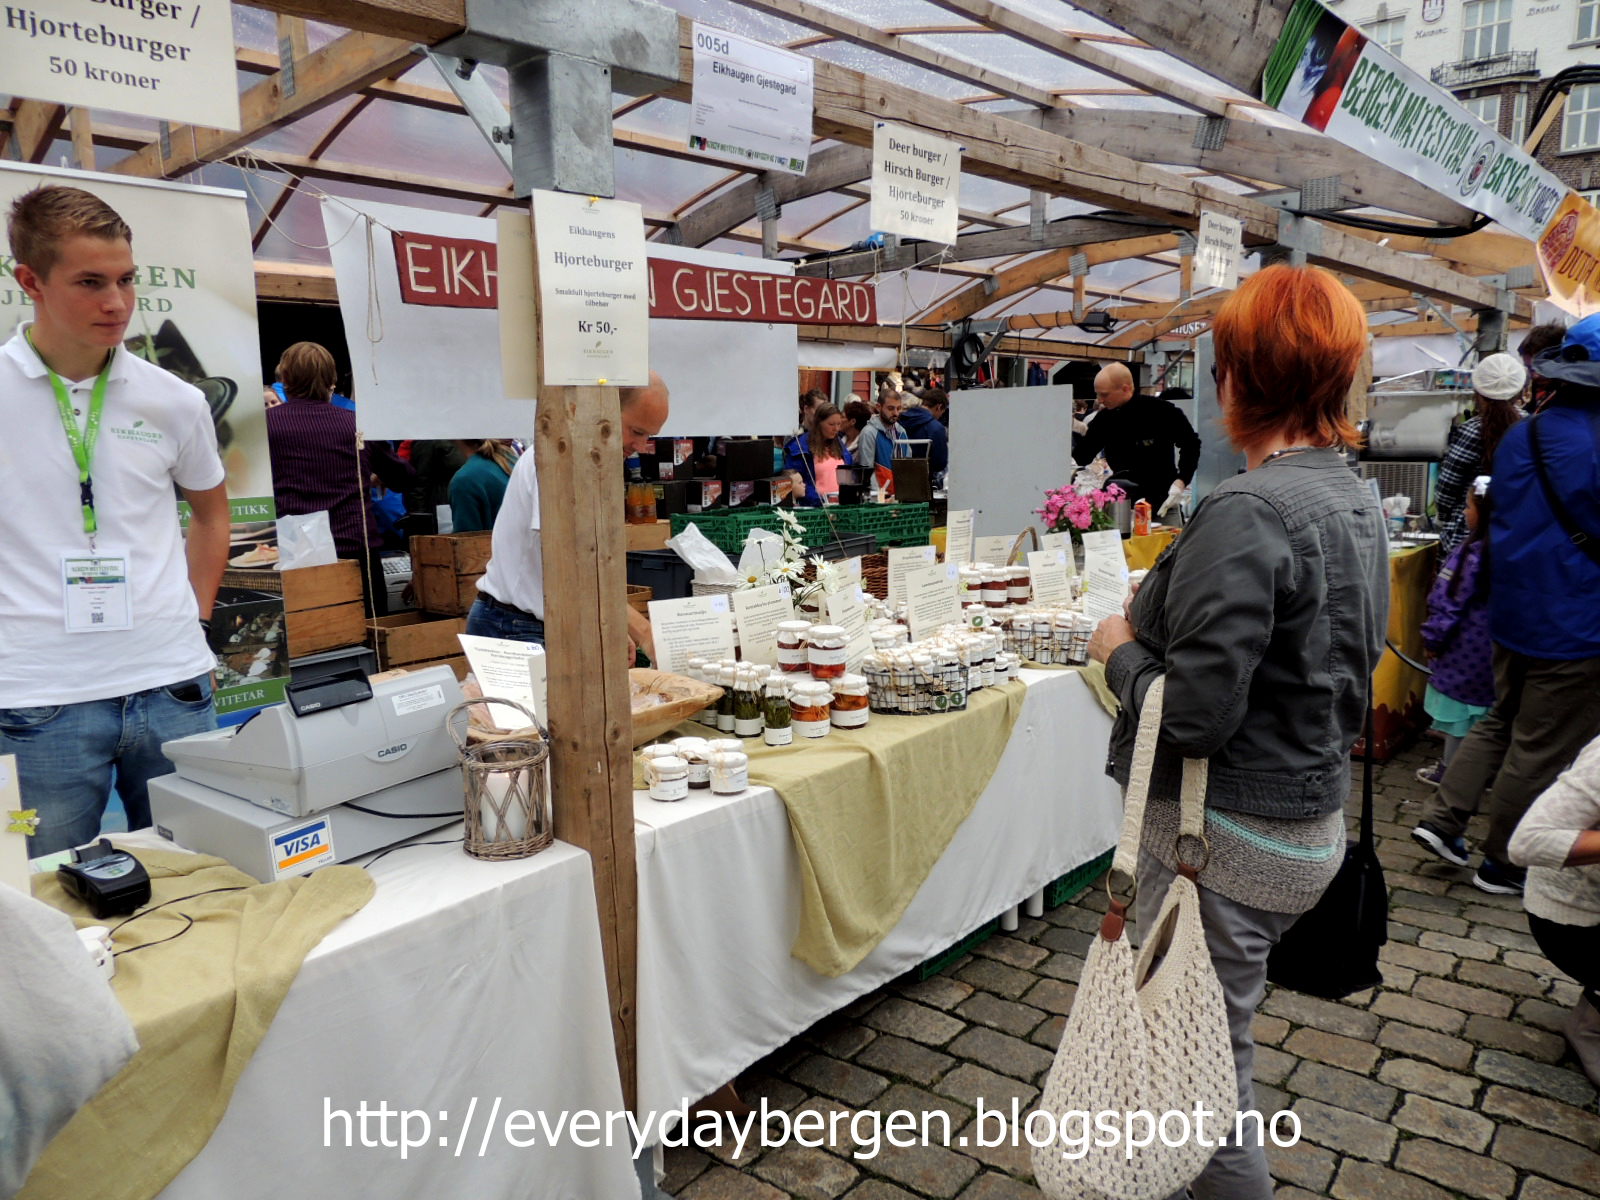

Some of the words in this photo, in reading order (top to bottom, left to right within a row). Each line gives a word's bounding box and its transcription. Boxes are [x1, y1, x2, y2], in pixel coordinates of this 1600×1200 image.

[90, 0, 182, 19] urger
[5, 6, 191, 62] Hjorteburger
[697, 33, 729, 55] 005d
[49, 56, 78, 76] 50
[85, 62, 161, 90] kroner
[713, 61, 755, 84] Eikhaugen
[756, 74, 797, 96] Gjestegard
[1341, 57, 1408, 133] BERGEN
[1390, 92, 1480, 175] MATFESTIVAL
[889, 138, 911, 155] Deer
[912, 144, 942, 163] burger
[884, 160, 913, 179] Hirsch
[915, 168, 945, 187] Burger
[889, 185, 945, 209] Hjorteburger
[900, 210, 909, 220] 50
[569, 225, 616, 239] Eikhaugens
[554, 251, 634, 272] Hjorteburger
[673, 268, 870, 322] GJESTEGARD
[578, 320, 593, 332] Kr
[596, 321, 617, 335] 50,-
[300, 702, 321, 712] CASIO
[377, 743, 408, 758] CASIO
[284, 833, 320, 856] VISA
